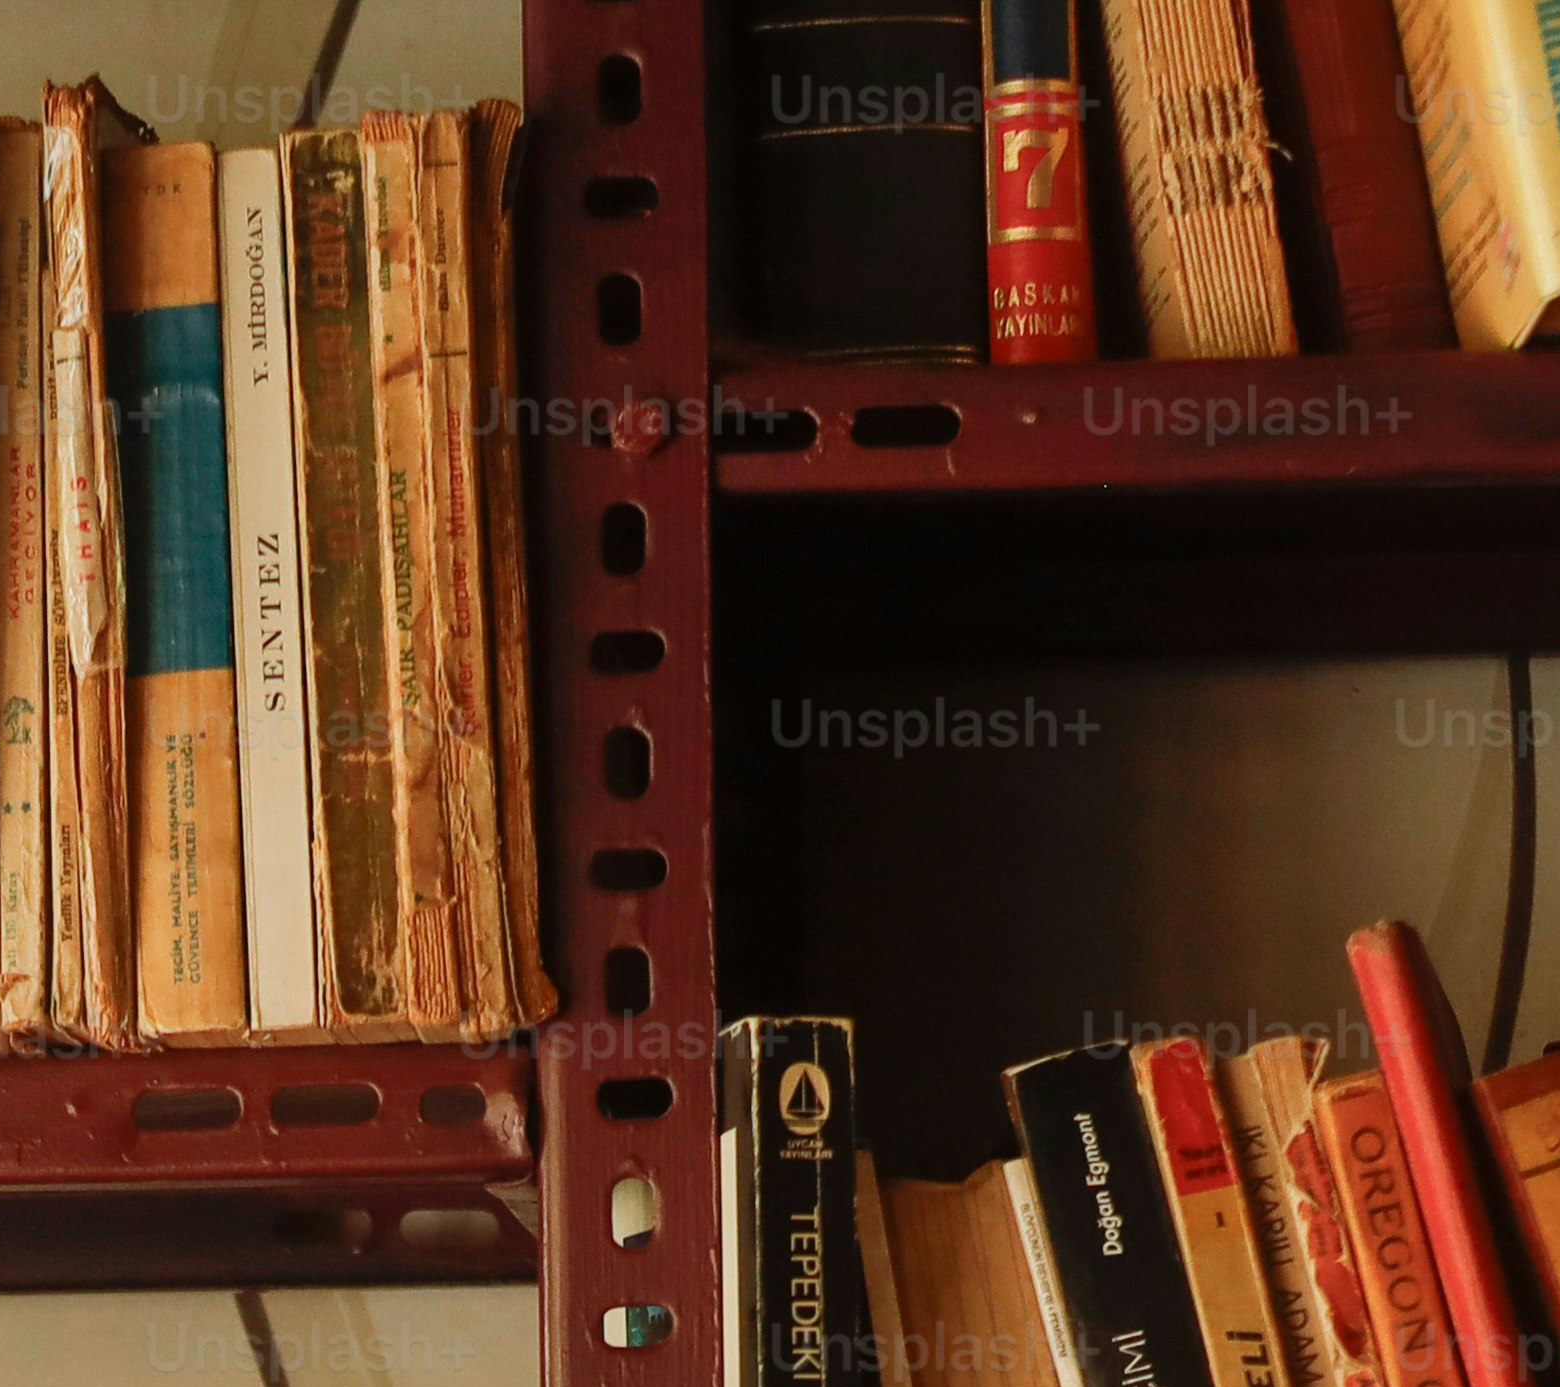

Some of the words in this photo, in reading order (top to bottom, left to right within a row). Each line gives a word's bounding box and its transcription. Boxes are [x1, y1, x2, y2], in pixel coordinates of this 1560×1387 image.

[1002, 127, 1066, 208] 7
[6, 445, 21, 619] KAHRAMANLAR
[265, 531, 286, 713] SENTEZ
[1075, 1111, 1115, 1189] Egmont
[1100, 1191, 1123, 1256] Doğan
